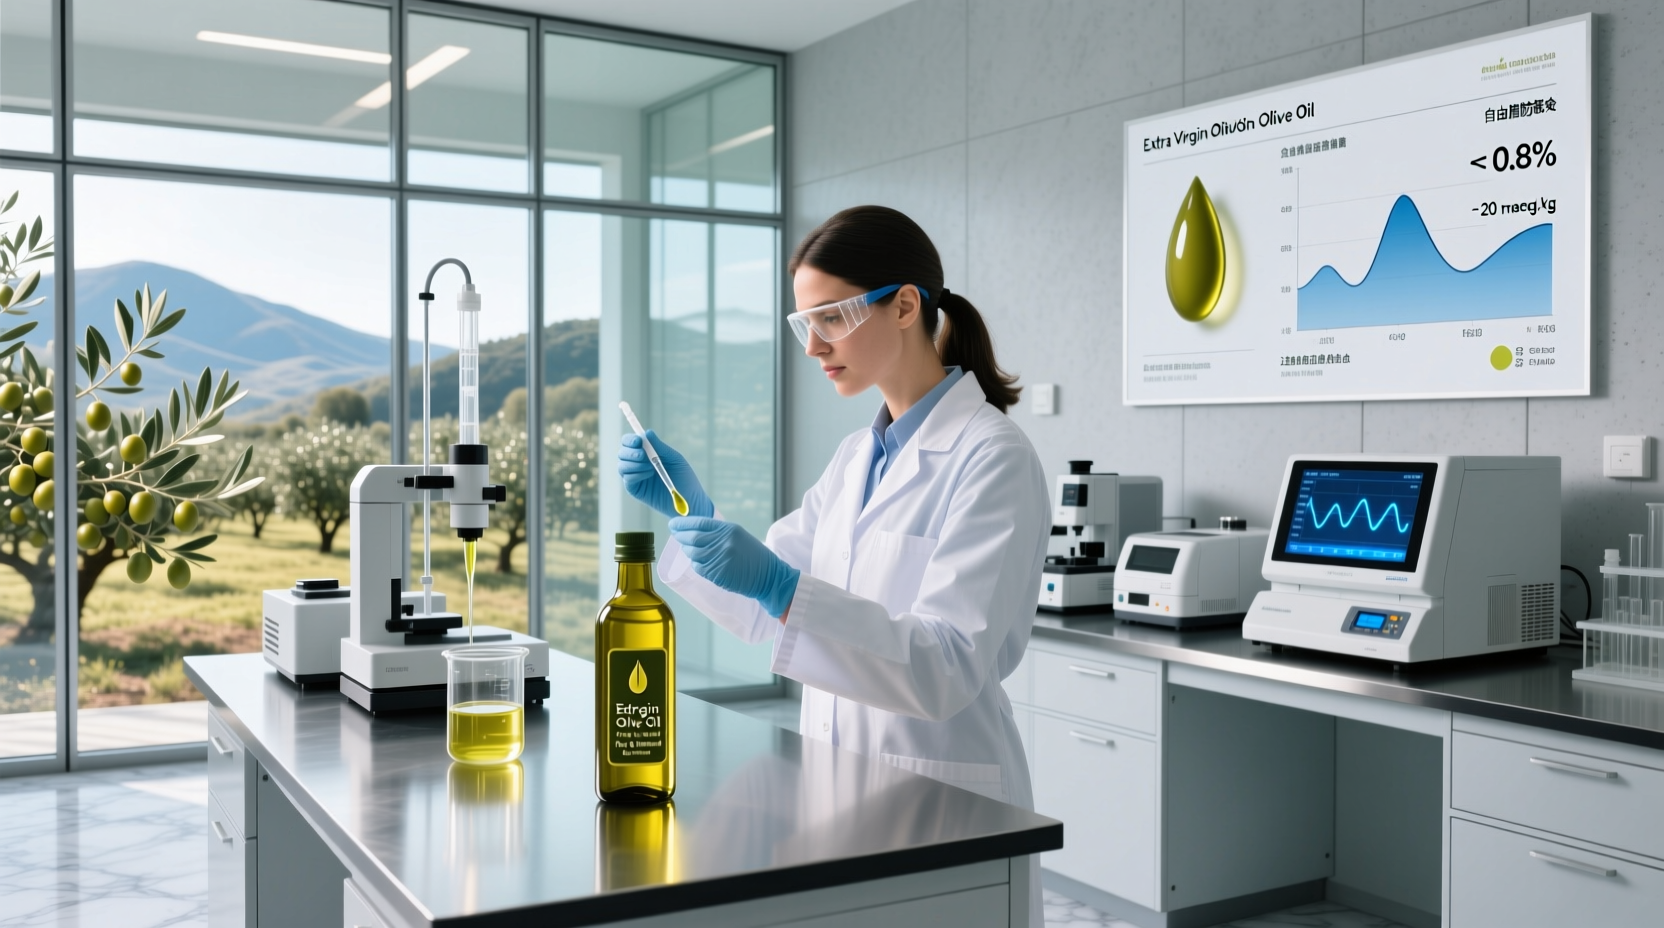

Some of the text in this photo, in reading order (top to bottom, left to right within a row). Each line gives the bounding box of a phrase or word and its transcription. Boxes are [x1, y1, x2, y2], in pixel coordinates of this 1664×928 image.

[1143, 137, 1171, 152] Extra
[1174, 127, 1208, 147] Virgin
[1258, 109, 1293, 128] Olive
[1296, 101, 1315, 120] Oil
